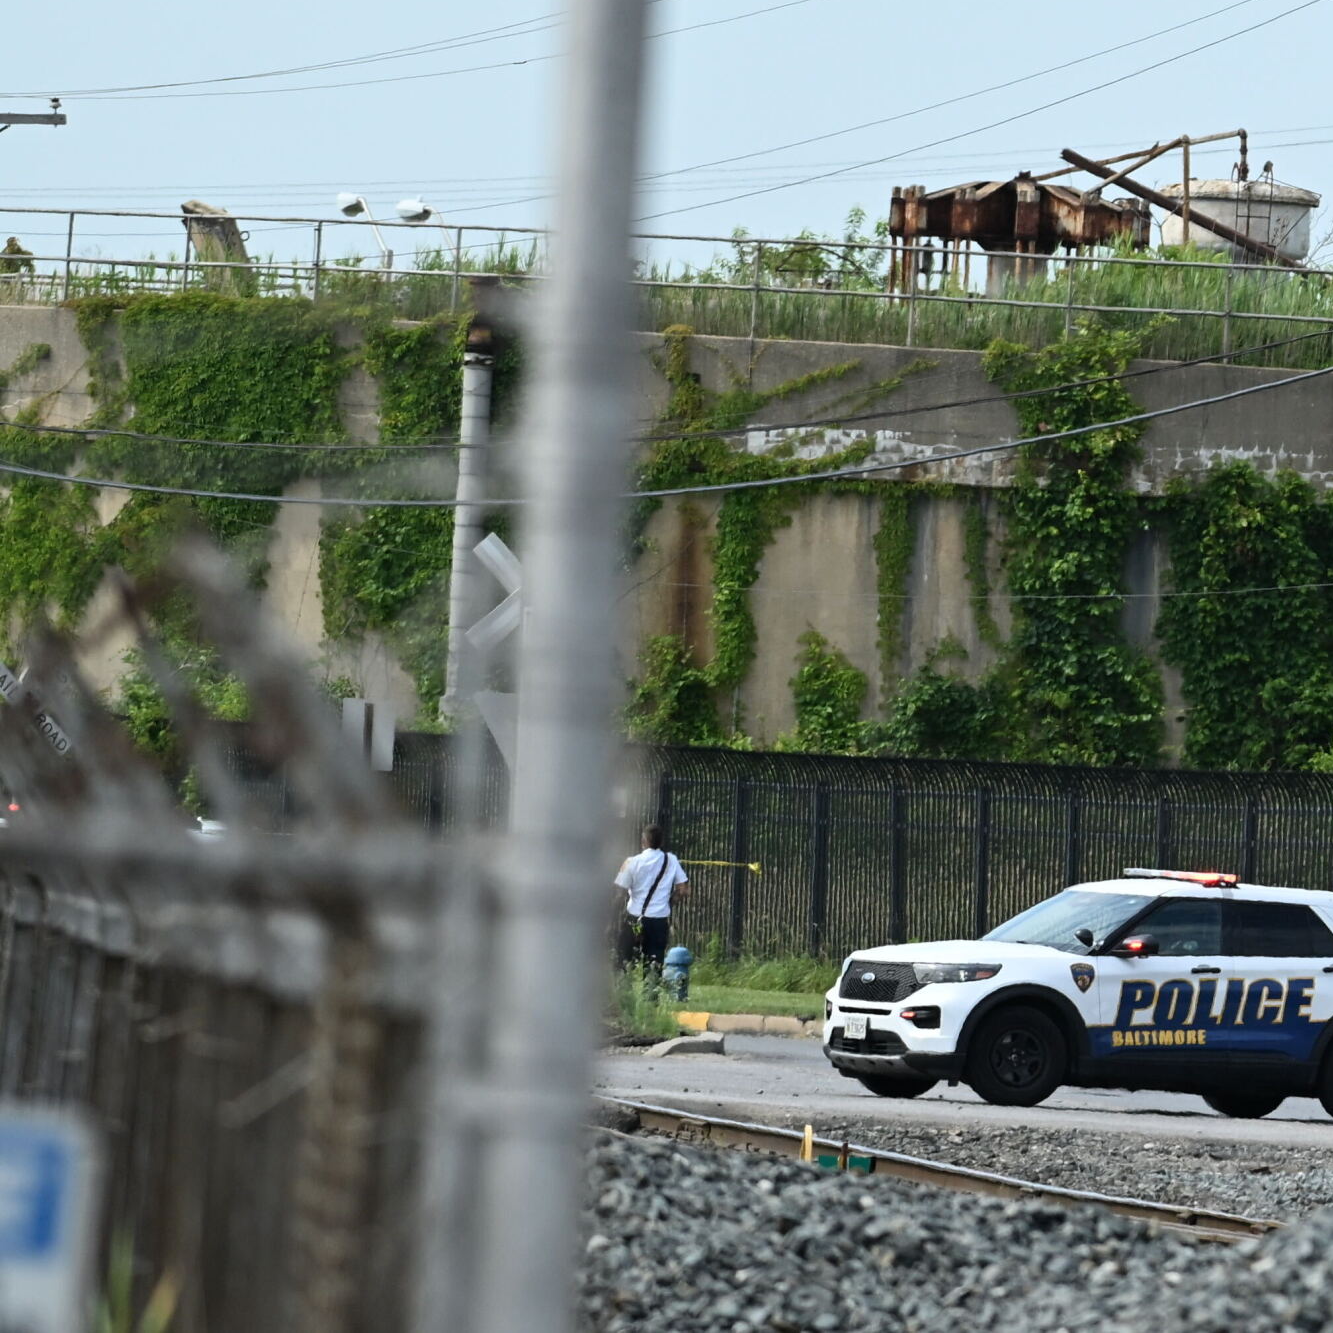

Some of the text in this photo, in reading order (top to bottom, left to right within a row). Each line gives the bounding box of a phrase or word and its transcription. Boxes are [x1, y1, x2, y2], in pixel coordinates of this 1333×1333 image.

[0, 673, 68, 752] AIL ROAD
[1114, 976, 1315, 1027] POLICE
[1112, 1029, 1207, 1047] BALTIMORE
